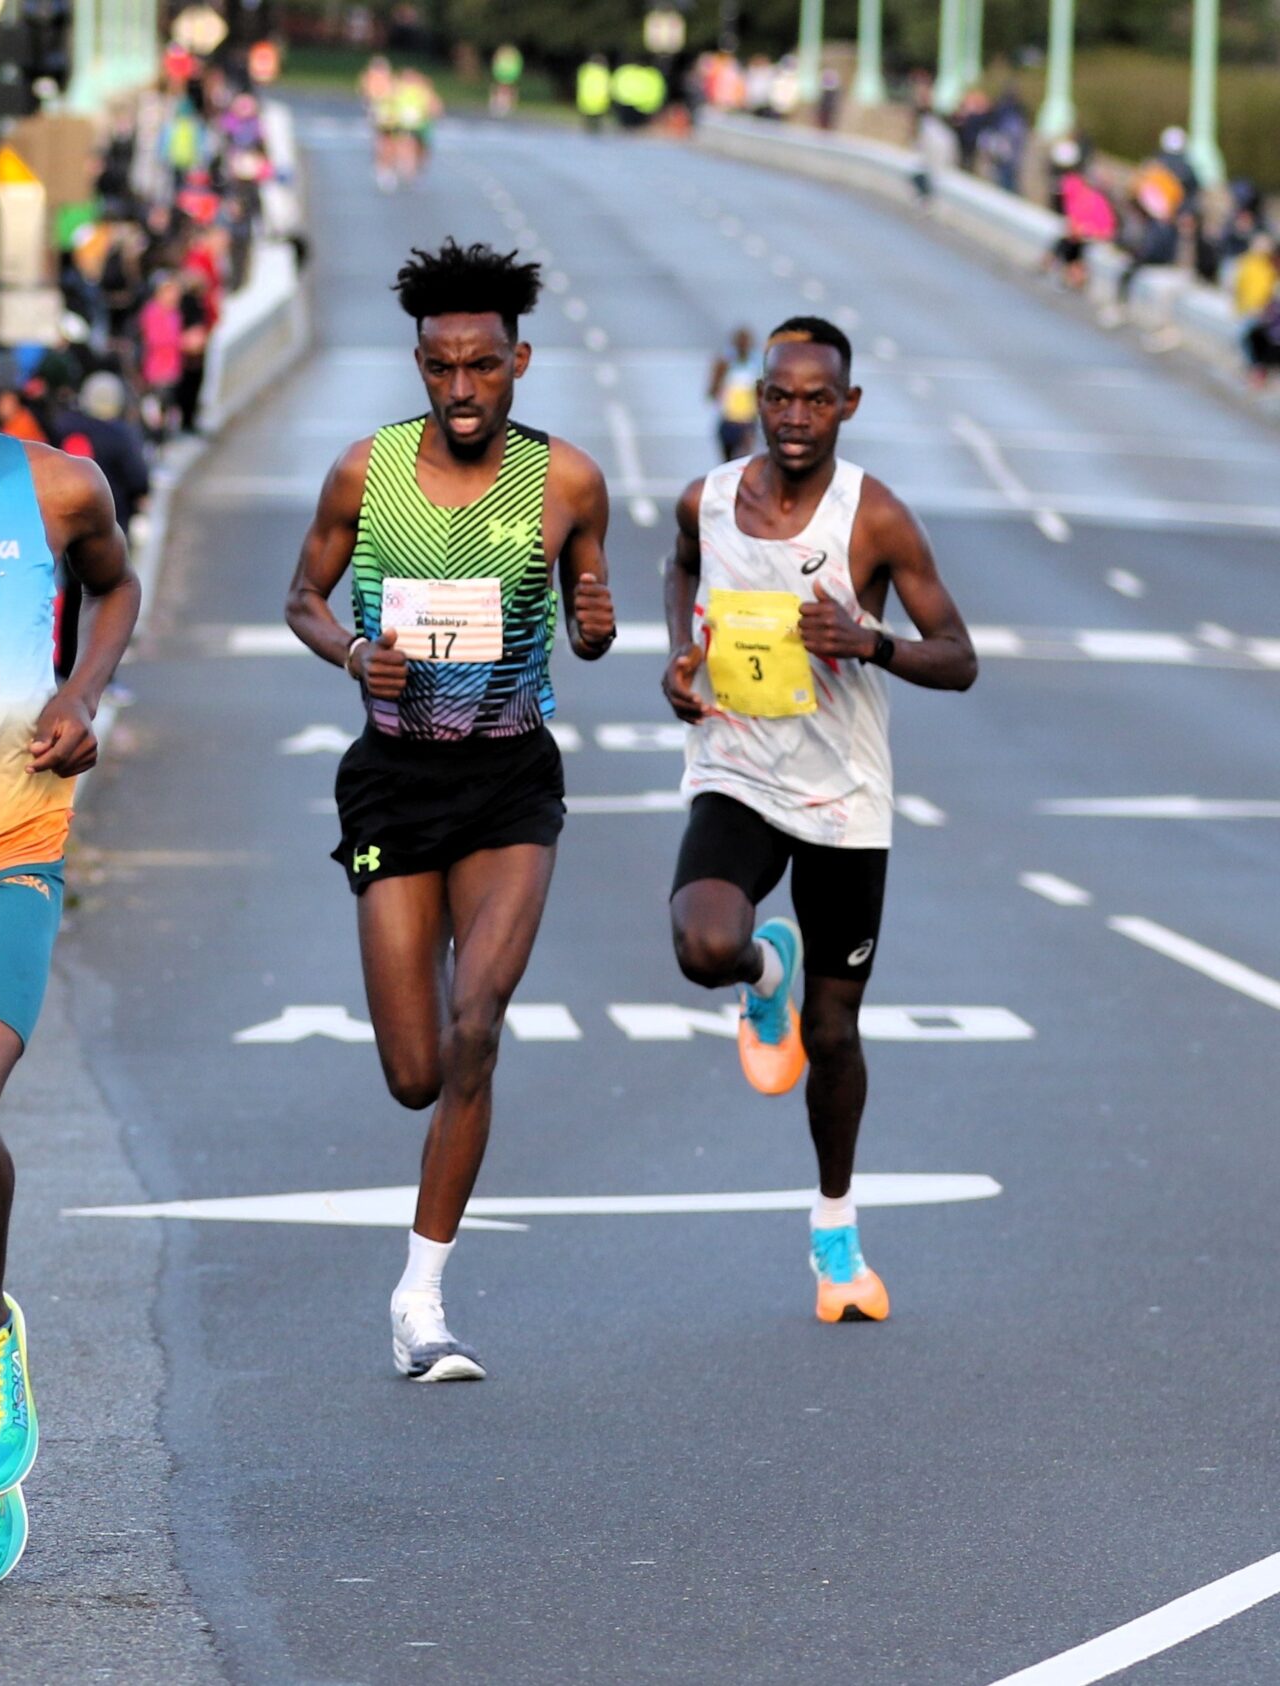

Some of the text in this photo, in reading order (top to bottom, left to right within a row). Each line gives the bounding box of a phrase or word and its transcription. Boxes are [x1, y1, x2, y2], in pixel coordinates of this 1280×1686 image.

[416, 616, 468, 627] Abbabiya
[428, 632, 457, 659] 17
[748, 655, 763, 681] 3
